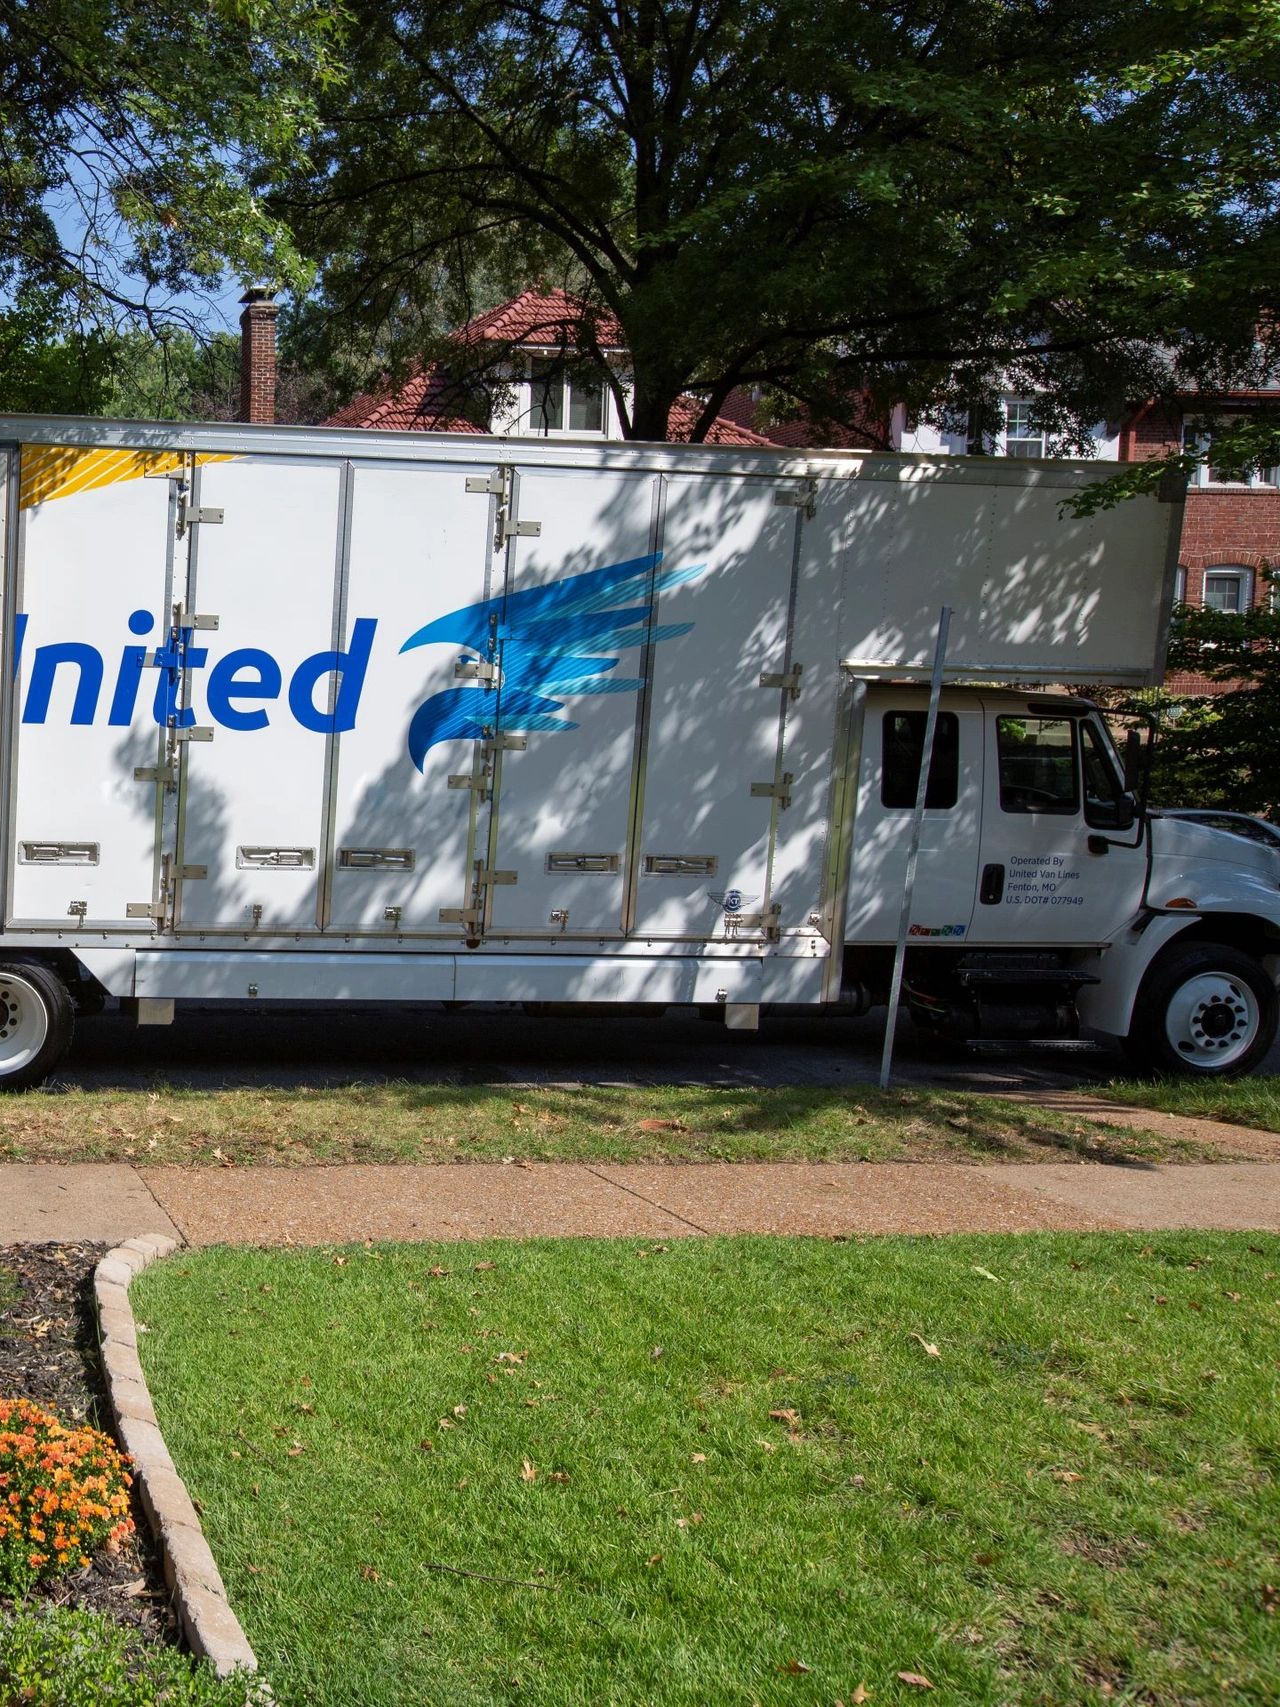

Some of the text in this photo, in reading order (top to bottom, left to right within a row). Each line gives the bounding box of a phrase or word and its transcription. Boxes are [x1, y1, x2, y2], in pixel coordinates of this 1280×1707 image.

[1010, 856, 1065, 867] Operated By
[1009, 870, 1081, 880] United Van Lines
[1007, 882, 1056, 892] Fenton, MO
[1006, 895, 1084, 906] U.S. DOT# 077949
